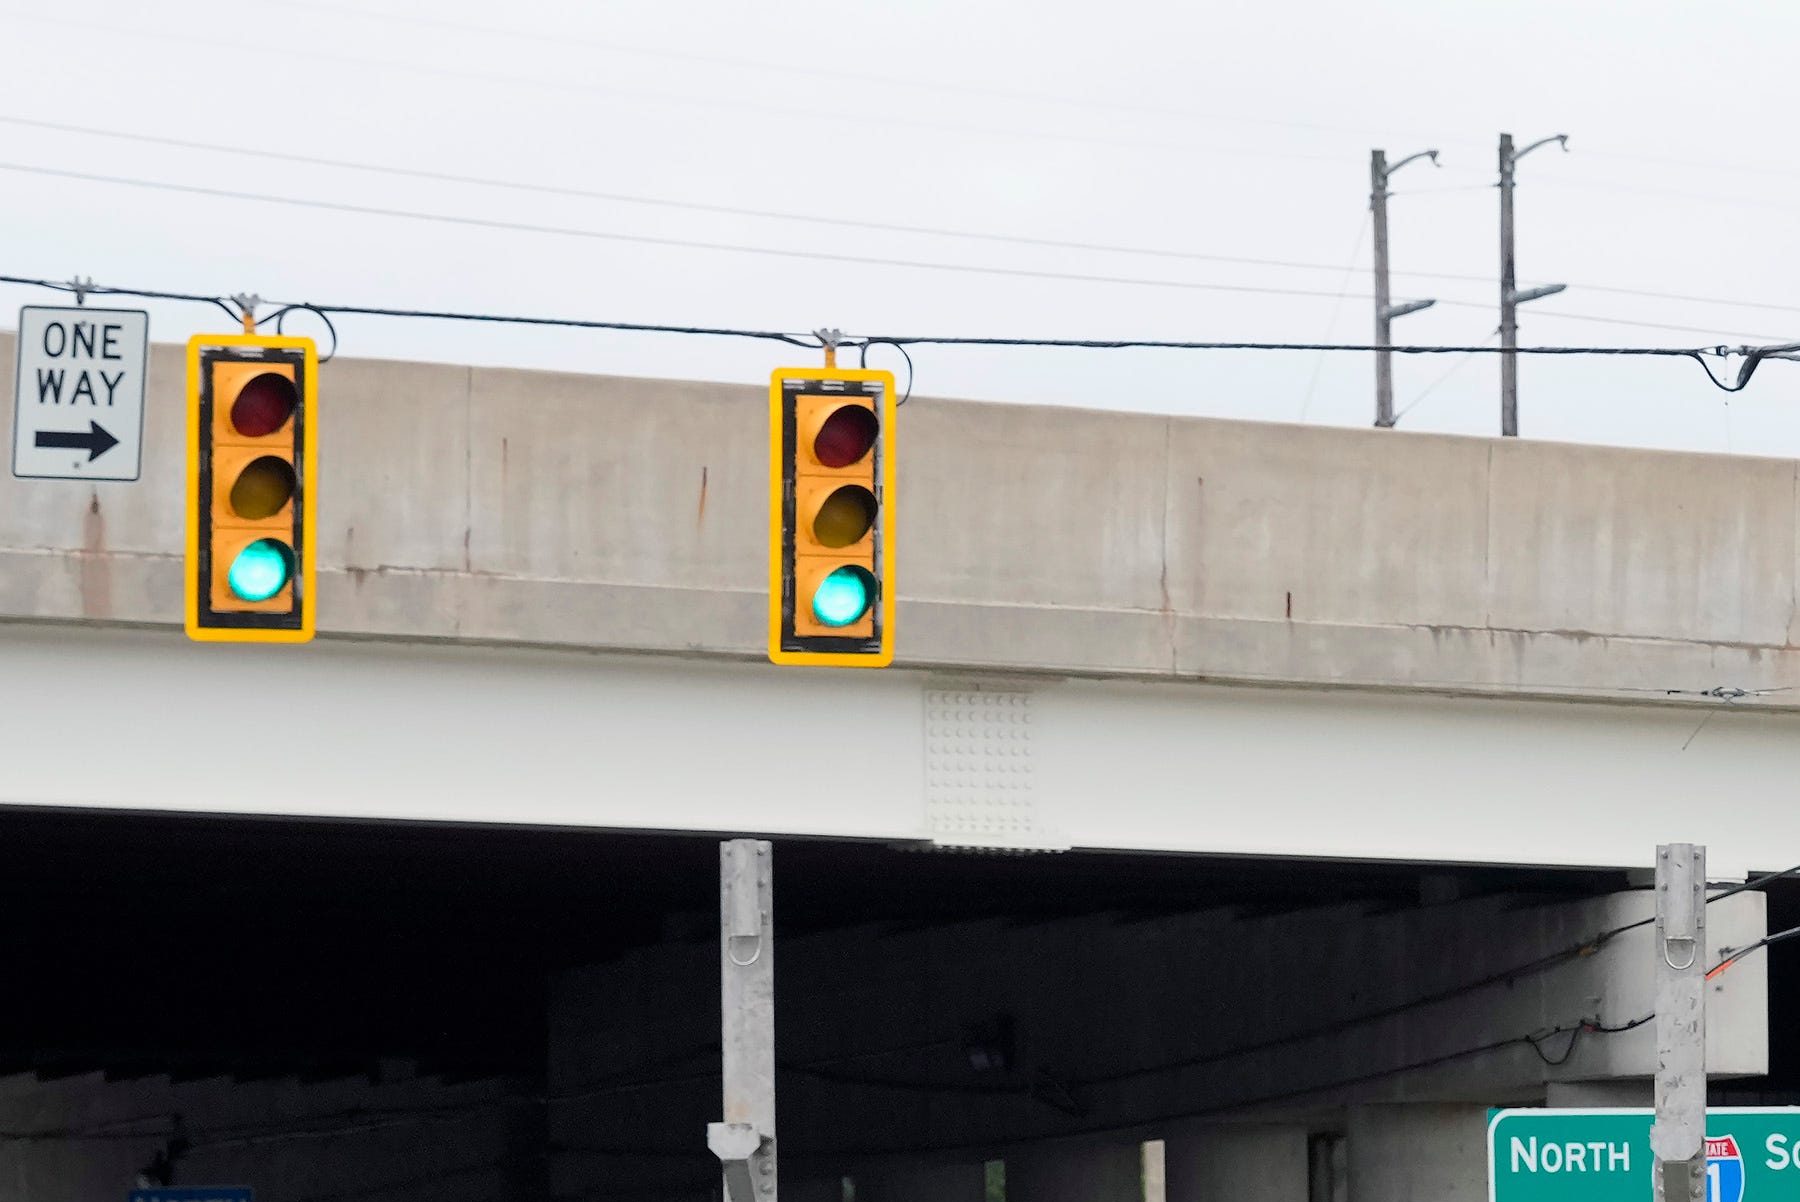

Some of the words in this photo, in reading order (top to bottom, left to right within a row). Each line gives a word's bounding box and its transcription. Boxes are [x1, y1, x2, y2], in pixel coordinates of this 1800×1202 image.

[43, 321, 123, 360] ONE
[37, 368, 126, 407] WAY
[1510, 1135, 1631, 1173] NORTH
